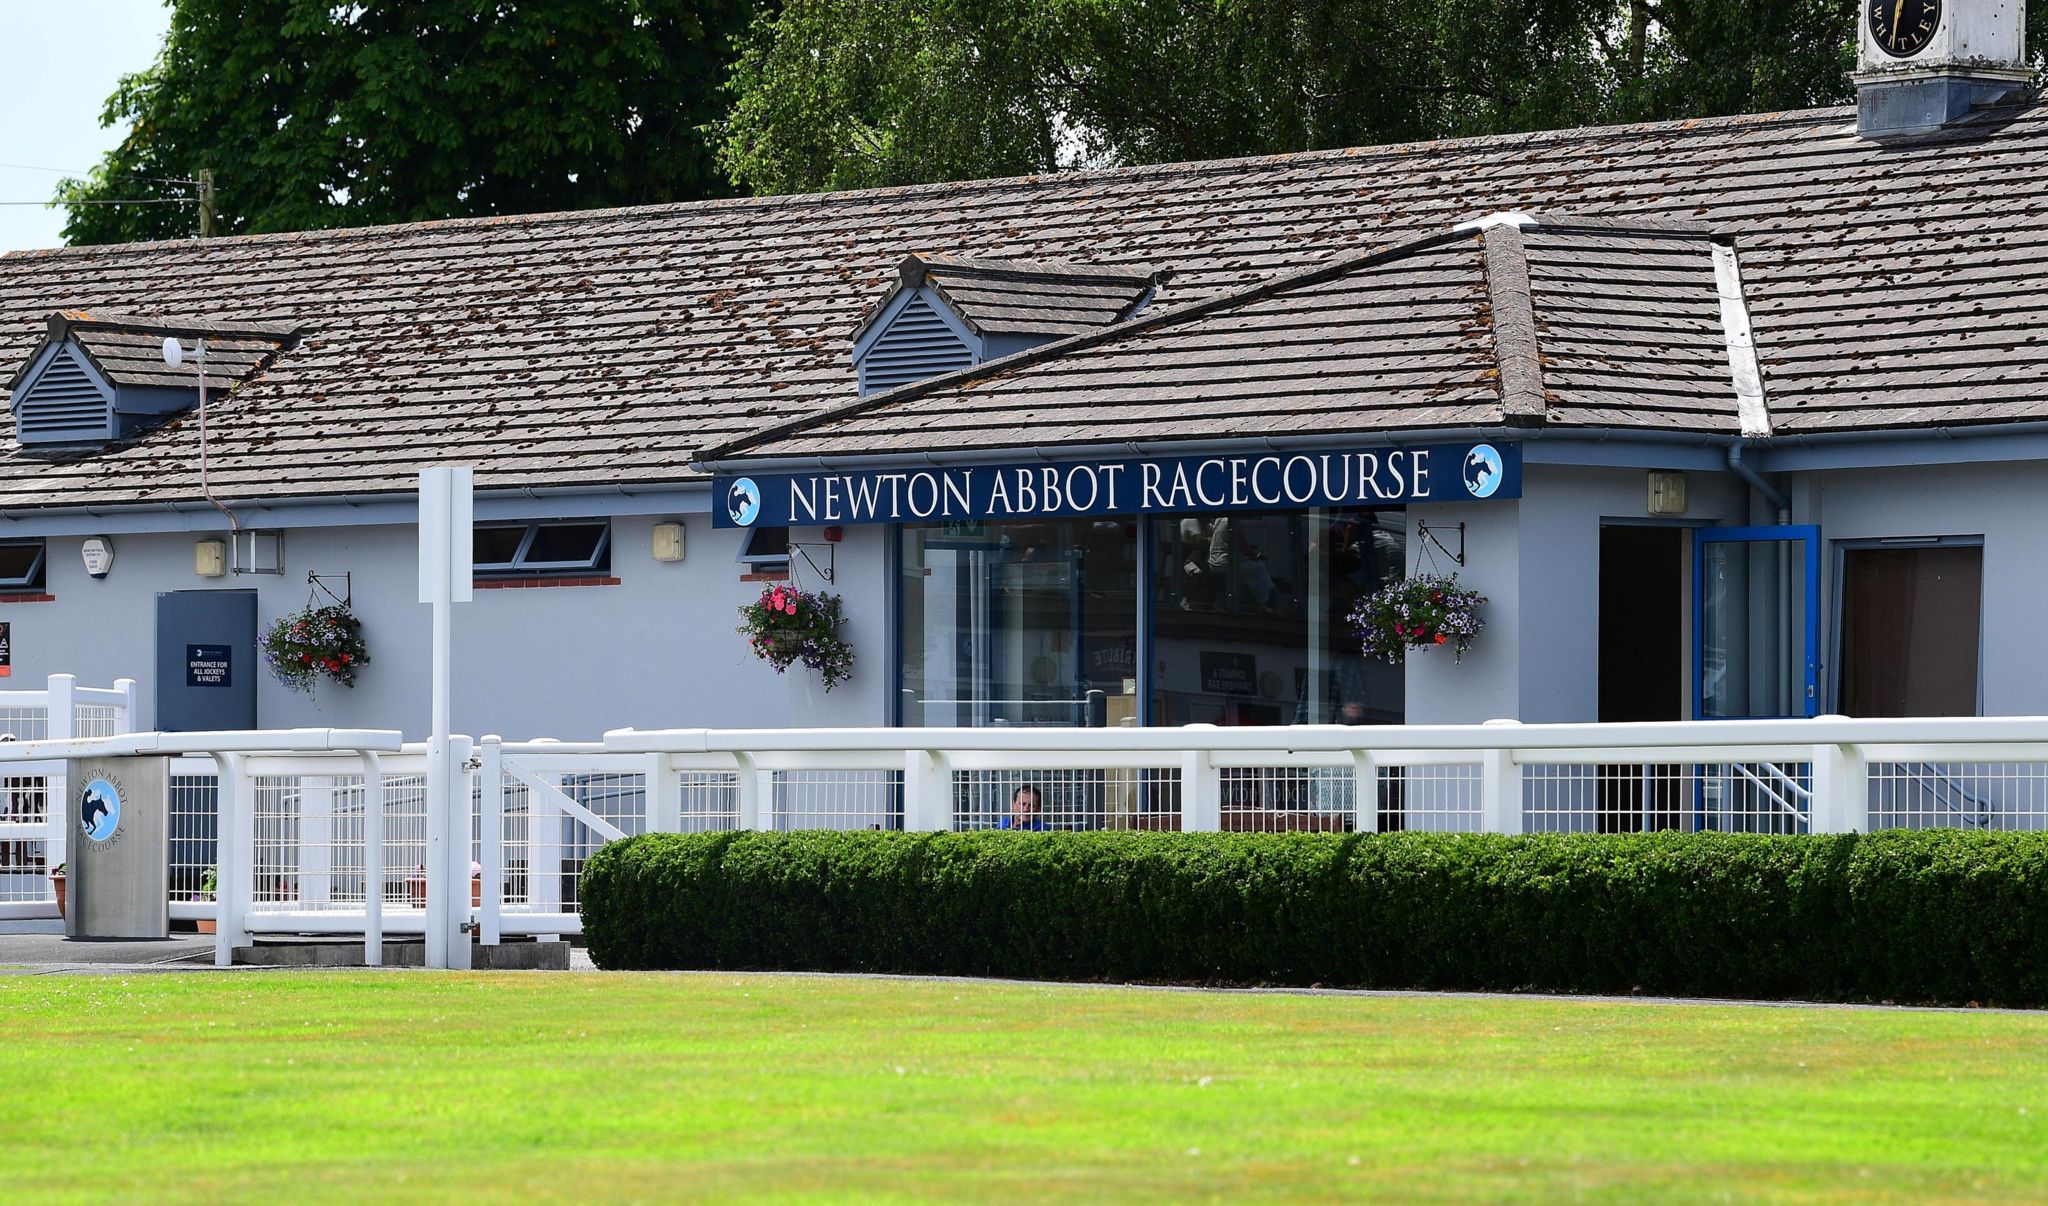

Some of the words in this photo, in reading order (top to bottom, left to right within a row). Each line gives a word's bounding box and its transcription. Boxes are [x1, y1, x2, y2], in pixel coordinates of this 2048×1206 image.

[1874, 2, 1936, 50] WHITLEY
[789, 472, 971, 520] NEWTON
[986, 465, 1123, 513] ABBOT
[1141, 451, 1430, 507] RACECOURSE
[203, 668, 225, 676] JOCKEYS
[106, 772, 128, 804] ABBOT
